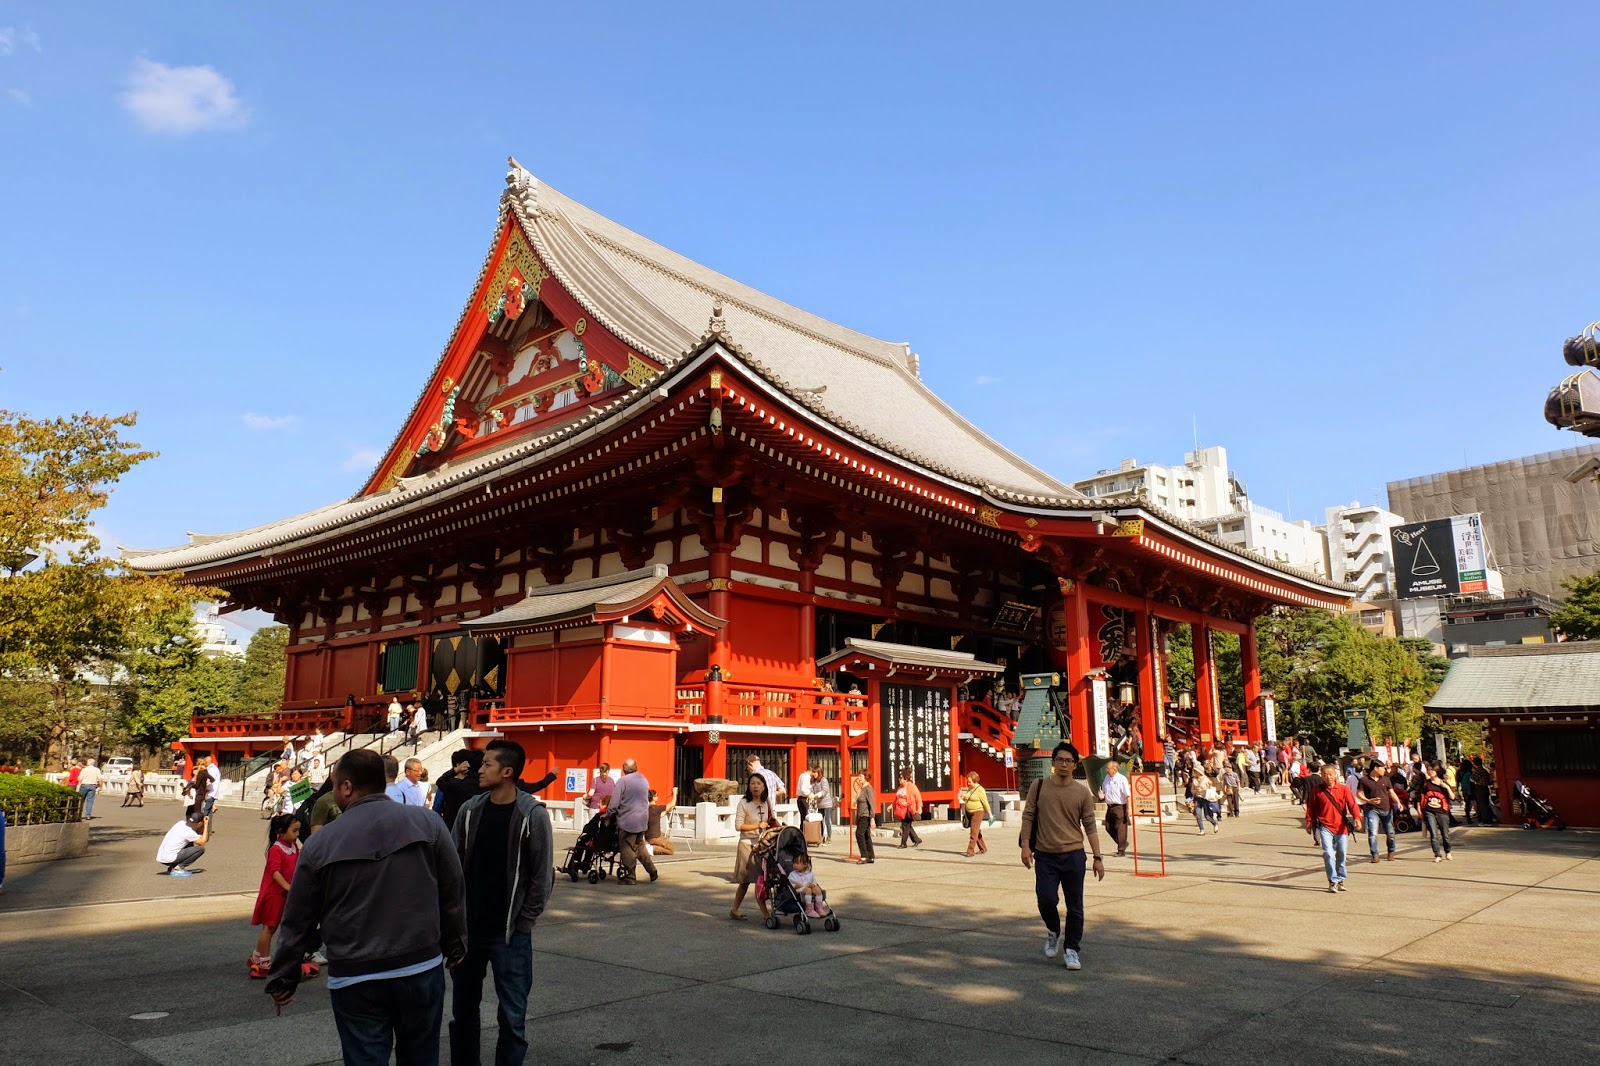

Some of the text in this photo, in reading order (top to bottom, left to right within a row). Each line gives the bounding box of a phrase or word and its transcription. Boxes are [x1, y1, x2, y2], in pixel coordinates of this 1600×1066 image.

[1410, 525, 1428, 539] Here!
[1412, 578, 1443, 587] AMUSE
[1409, 583, 1447, 593] MUSEUM
